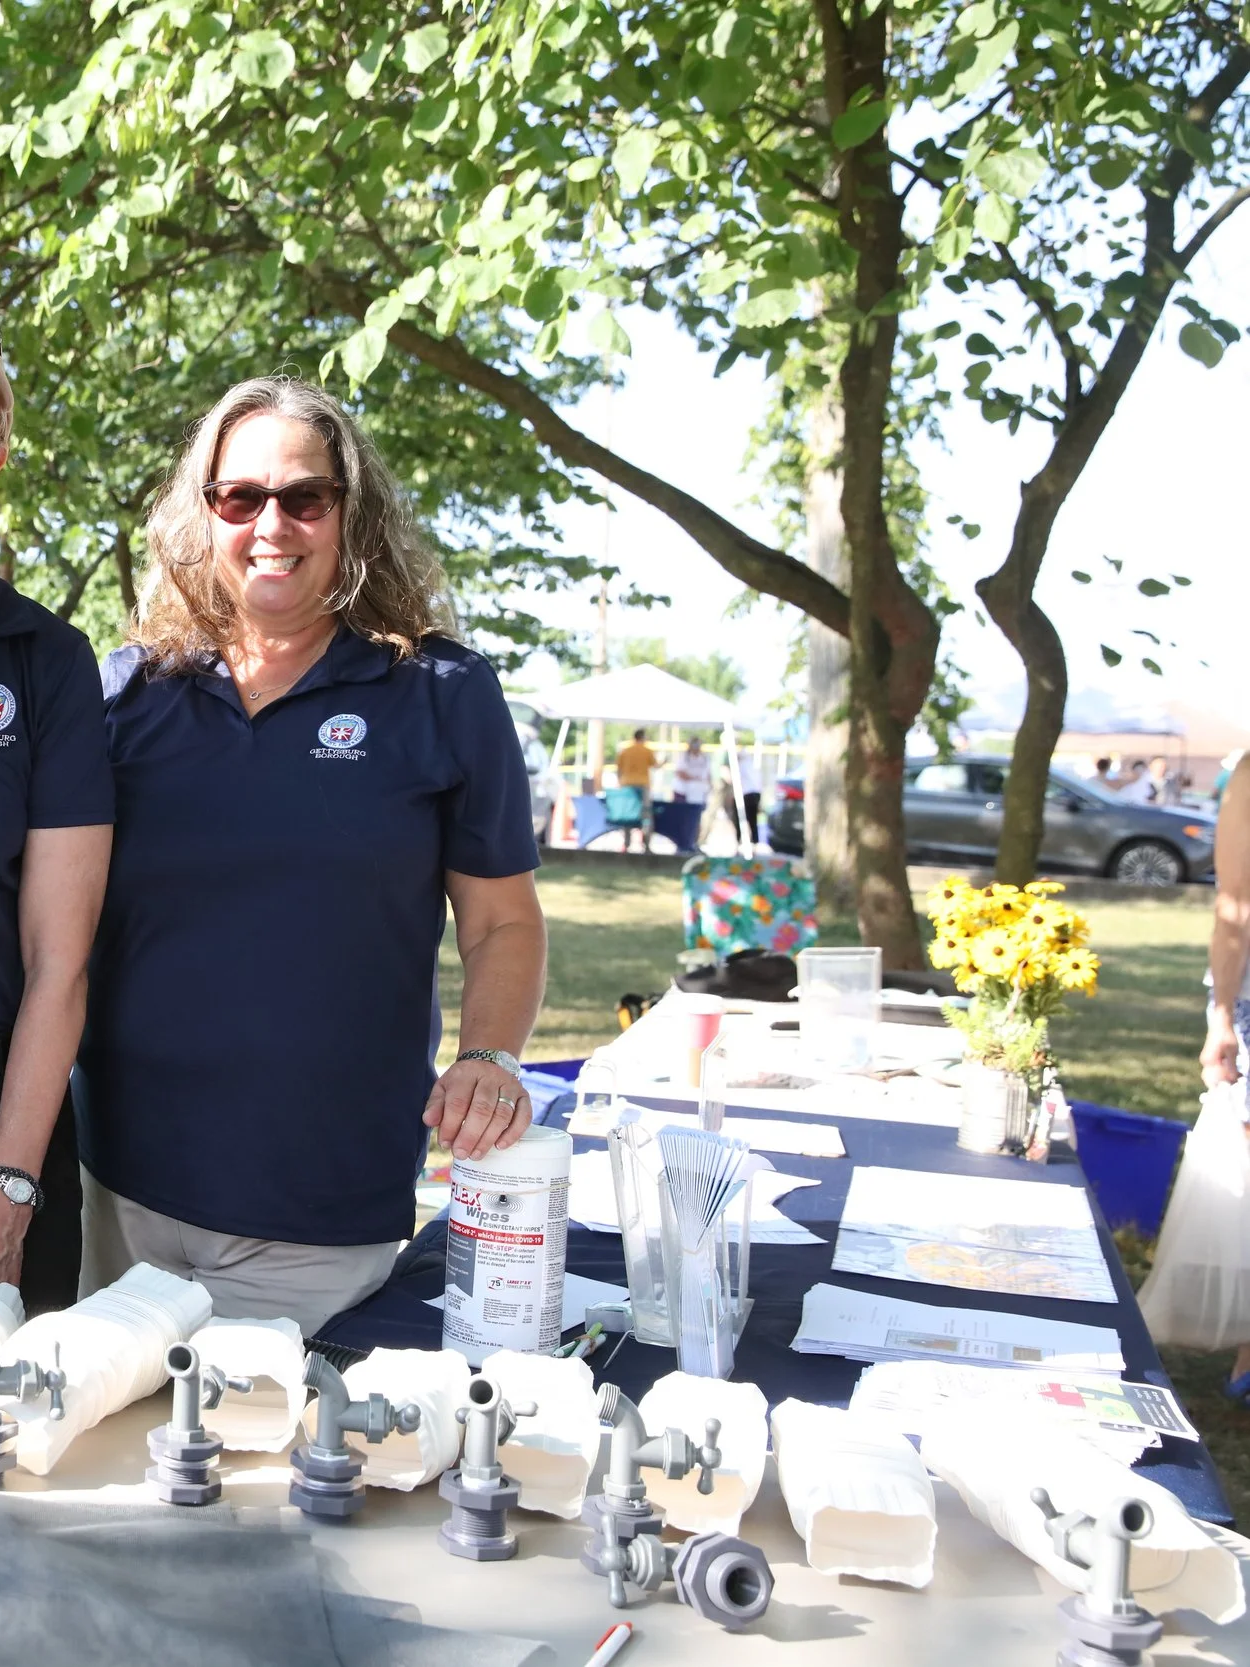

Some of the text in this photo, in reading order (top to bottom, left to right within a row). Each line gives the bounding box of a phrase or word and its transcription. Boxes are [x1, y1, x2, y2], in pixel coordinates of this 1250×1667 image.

[310, 748, 366, 757] GETTYSBURG
[315, 753, 358, 761] BOROUGH
[466, 1205, 510, 1226] Wipes
[483, 1222, 523, 1231] DISINFECTANT
[478, 1231, 495, 1241] which
[495, 1235, 515, 1243] causes
[515, 1236, 542, 1244] COVID-19
[490, 1279, 501, 1287] 75
